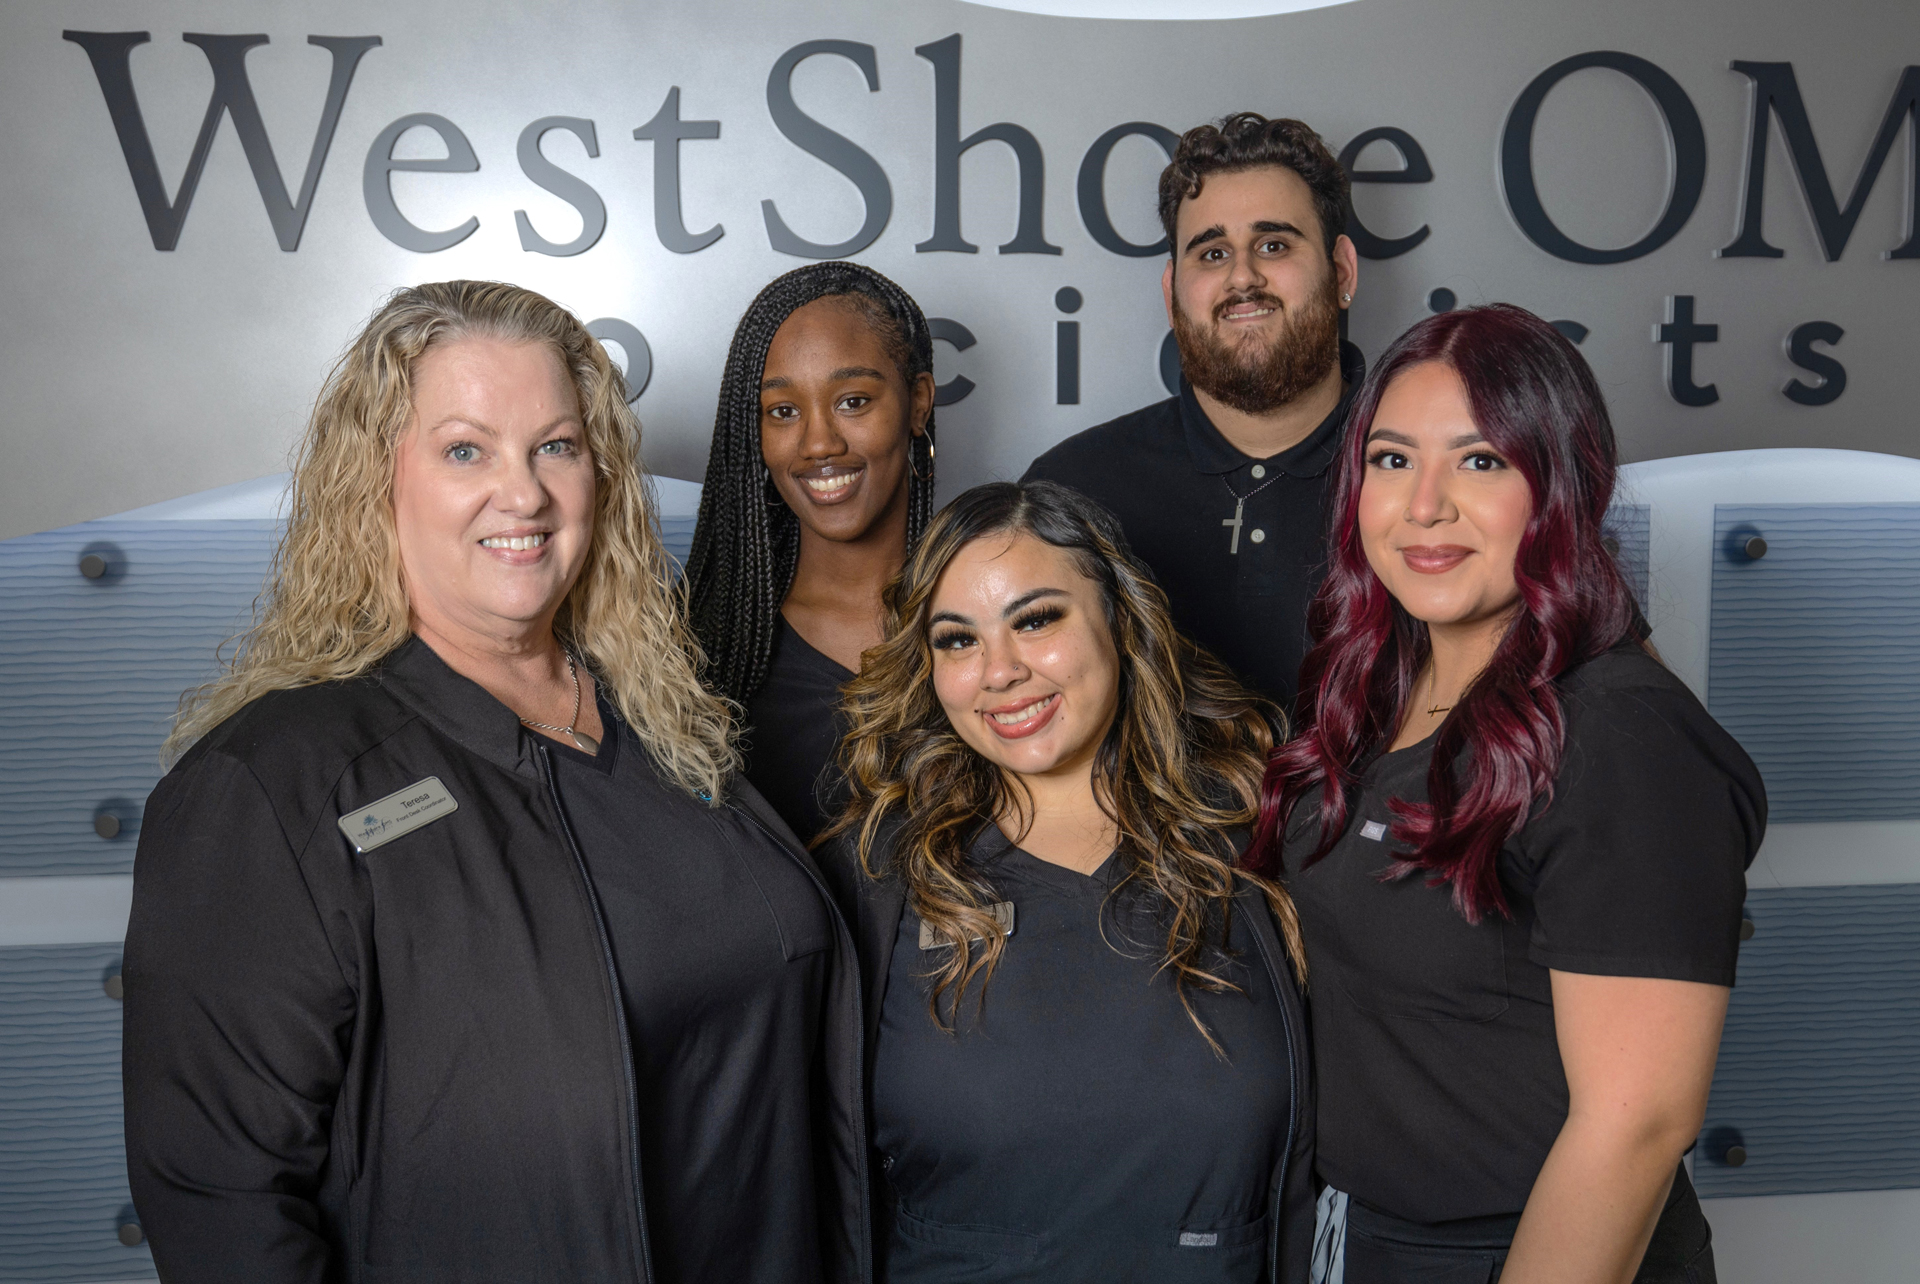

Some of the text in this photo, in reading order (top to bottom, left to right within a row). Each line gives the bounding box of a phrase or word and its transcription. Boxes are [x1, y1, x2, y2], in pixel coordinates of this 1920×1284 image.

[63, 29, 1434, 258] WestShoe
[396, 796, 447, 823] Front Desk Coordinator
[400, 792, 430, 809] Teresa
